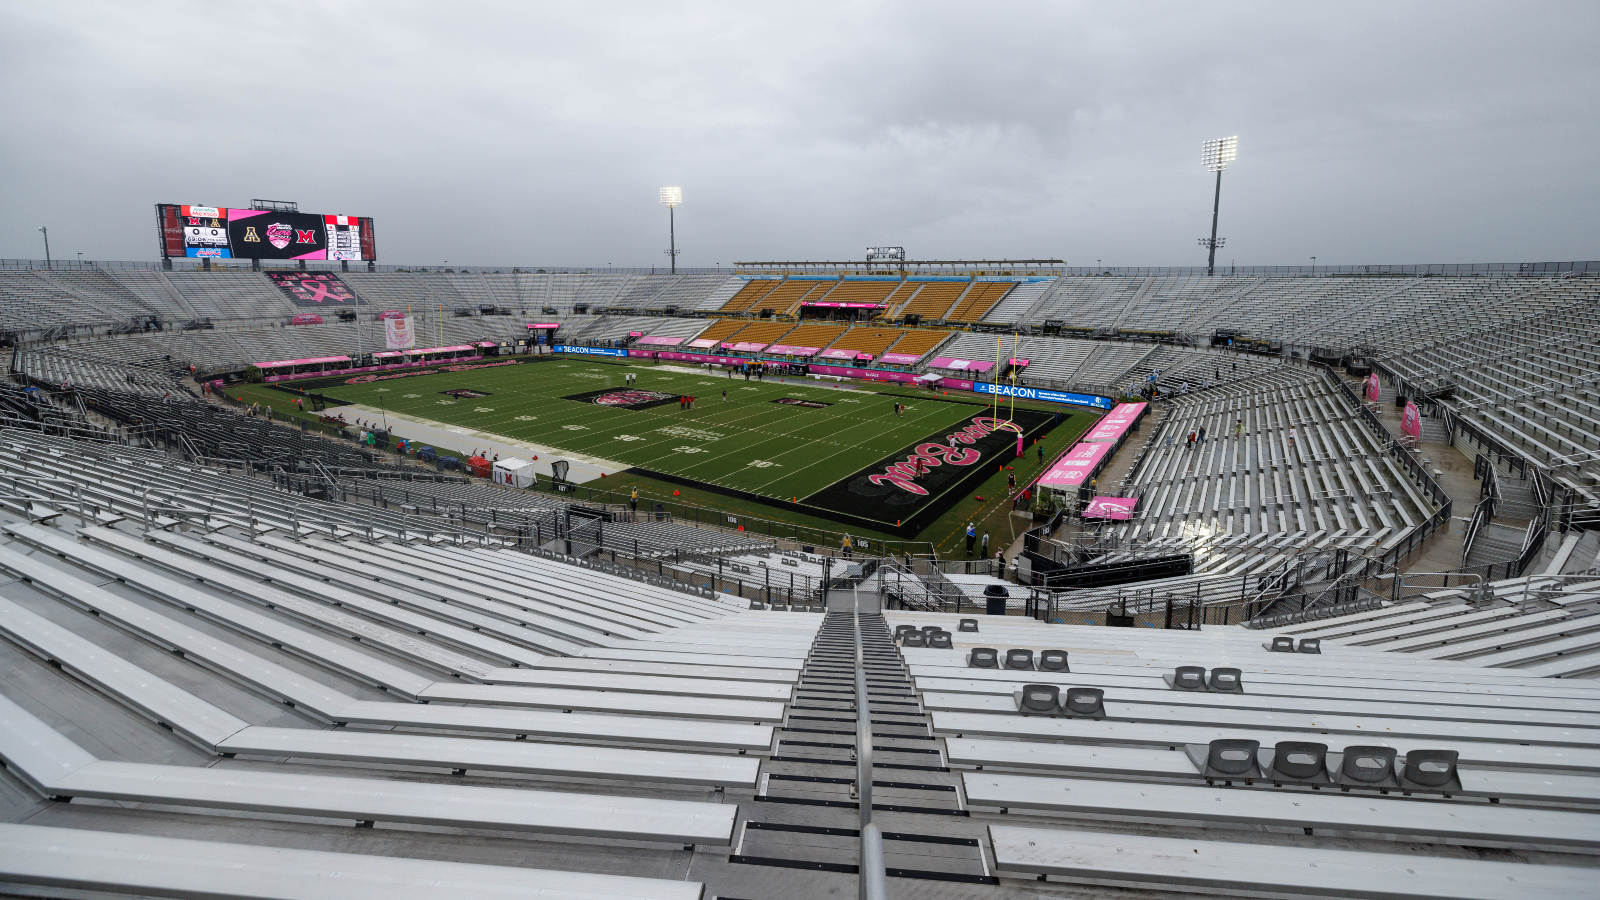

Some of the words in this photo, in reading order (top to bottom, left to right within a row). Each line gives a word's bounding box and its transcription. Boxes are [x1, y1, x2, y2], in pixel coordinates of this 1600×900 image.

[244, 226, 260, 242] A
[295, 229, 318, 244] M
[563, 345, 589, 354] BEACON
[988, 384, 1036, 399] BEACON
[671, 446, 702, 454] 20
[727, 516, 738, 524] 106
[856, 539, 869, 549] 105
